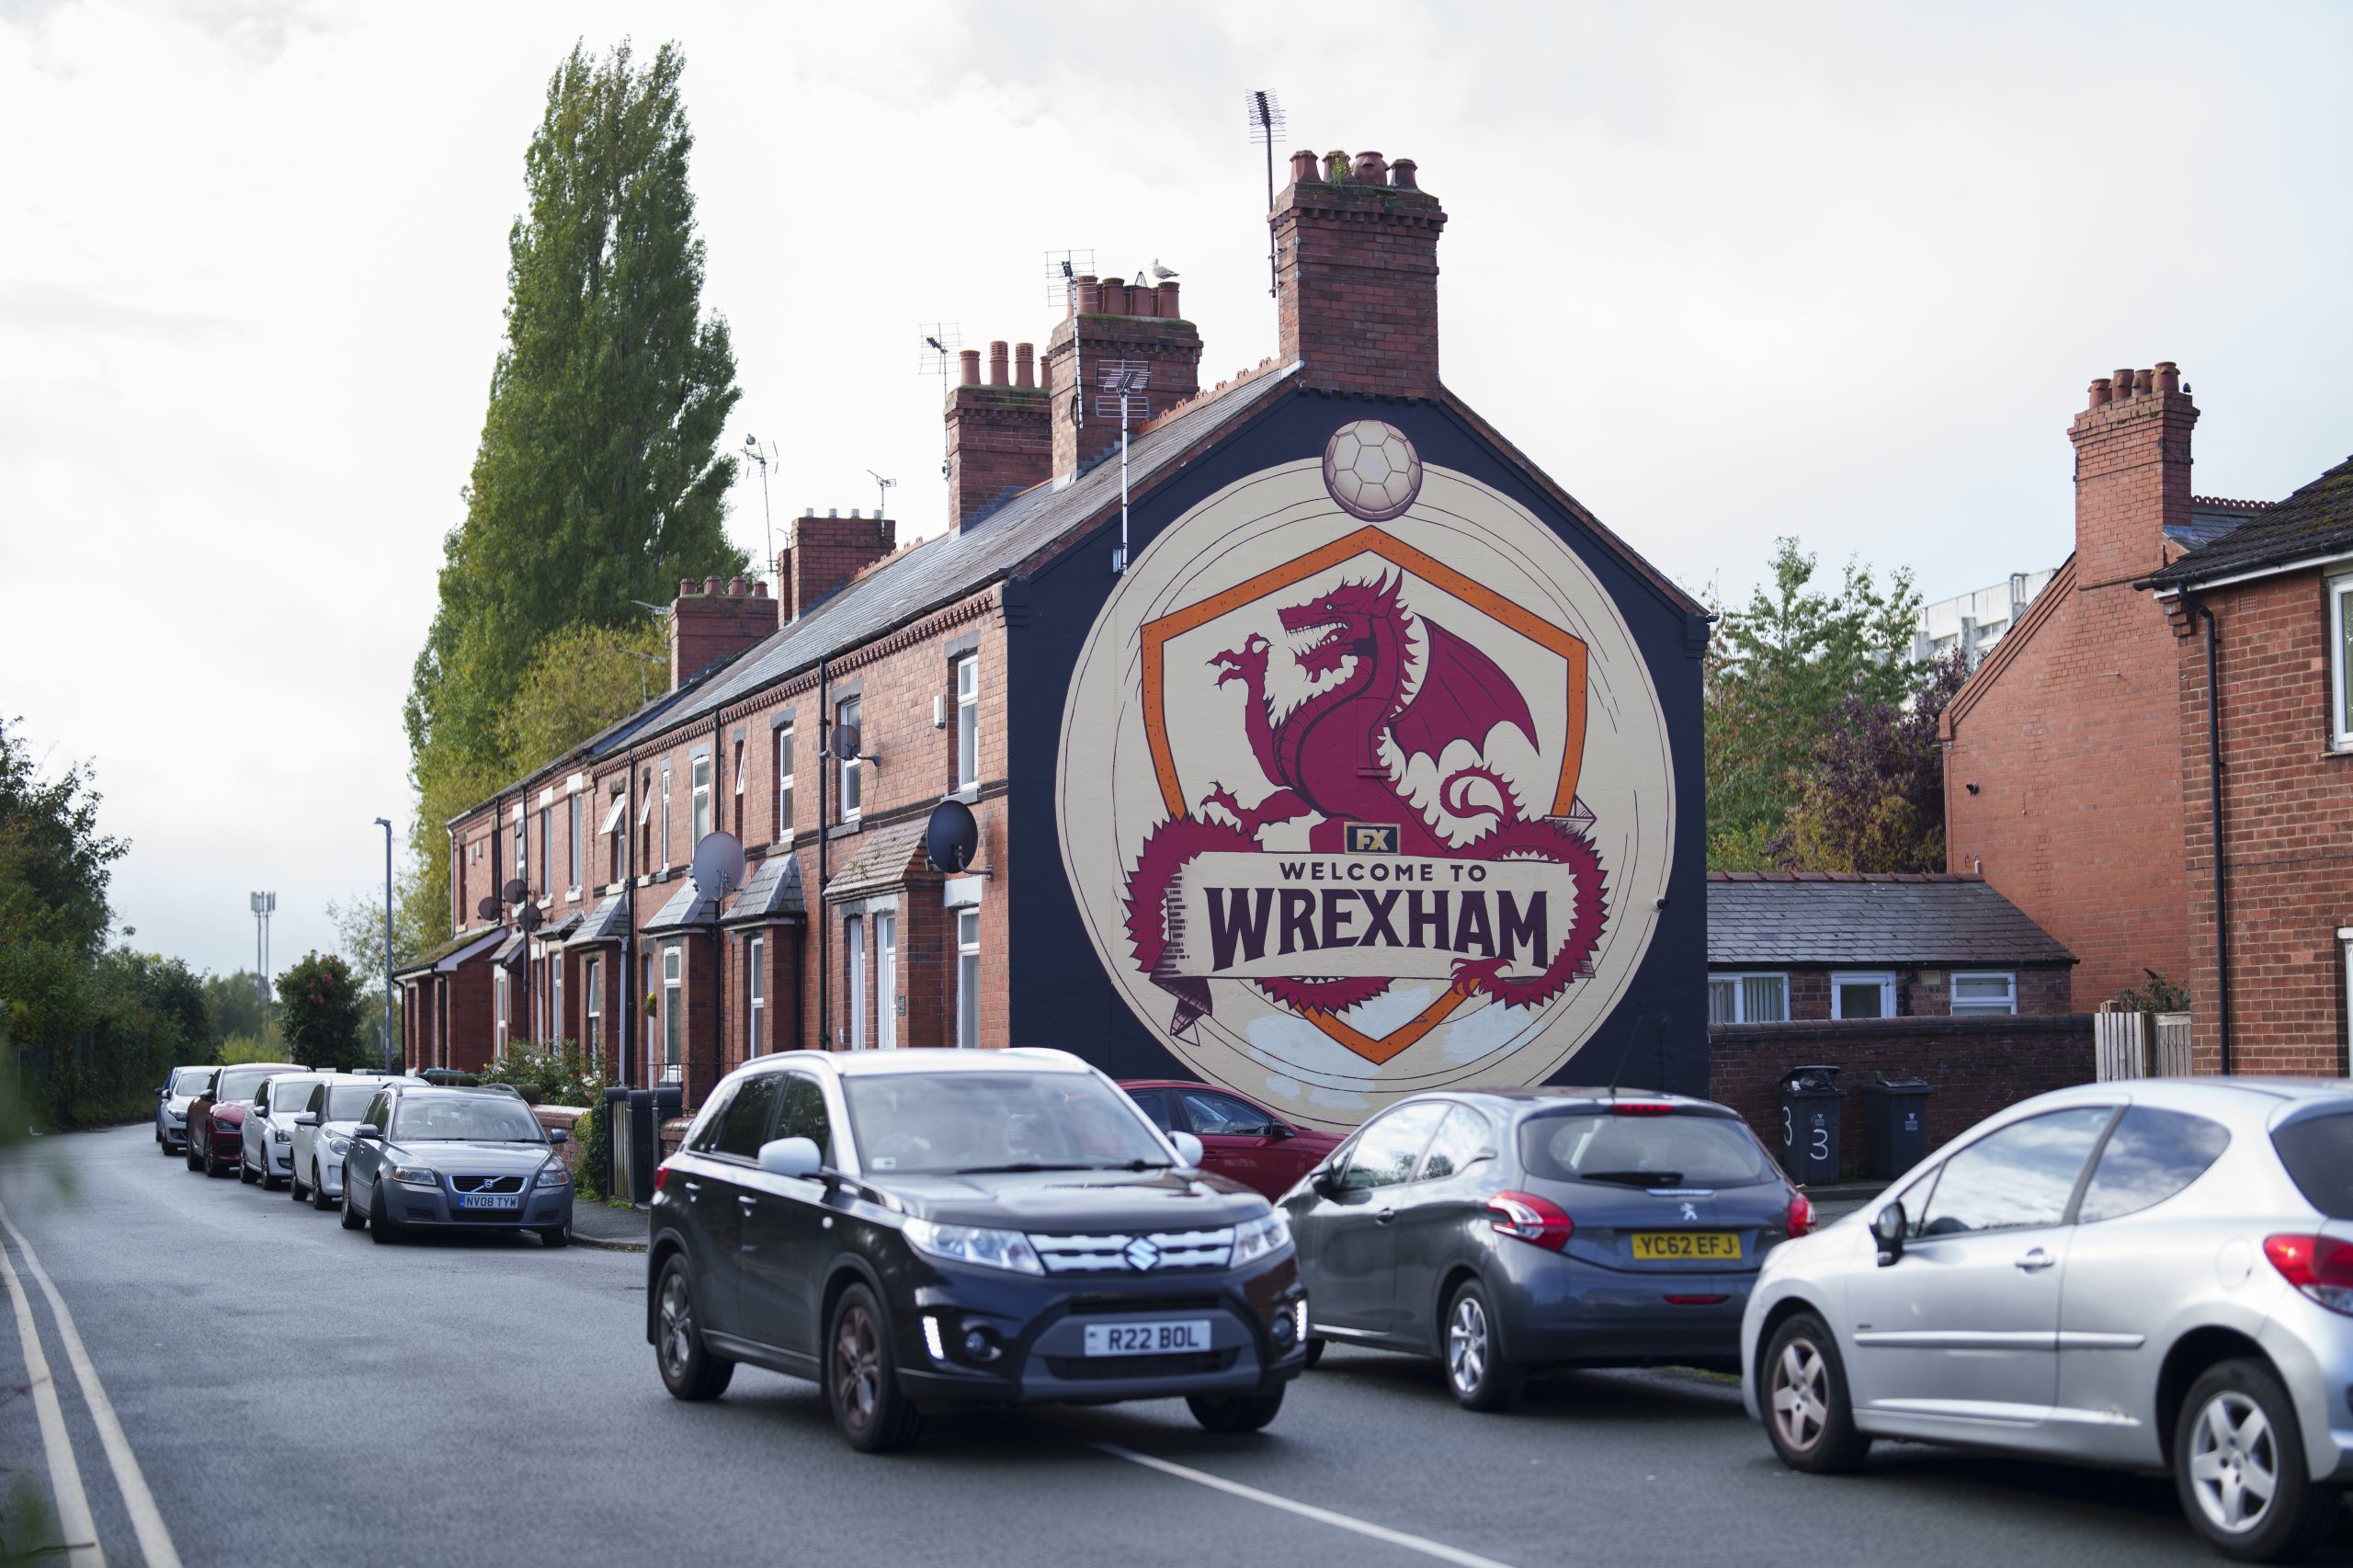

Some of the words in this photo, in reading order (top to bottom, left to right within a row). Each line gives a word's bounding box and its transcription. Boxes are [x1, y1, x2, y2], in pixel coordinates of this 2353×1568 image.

[1356, 828, 1391, 851] FX
[1279, 861, 1434, 882] WELCOME
[1449, 863, 1487, 882] TO
[1202, 887, 1549, 972] WREXHAM
[1782, 1106, 1792, 1147] 3
[1809, 1128, 1829, 1161] 3
[466, 1197, 494, 1207] NV08
[496, 1197, 517, 1207] TYW
[1640, 1235, 1693, 1256] YC62
[1696, 1235, 1734, 1256] EFJ
[1108, 1327, 1153, 1351] R22
[1158, 1324, 1199, 1349] BOL
